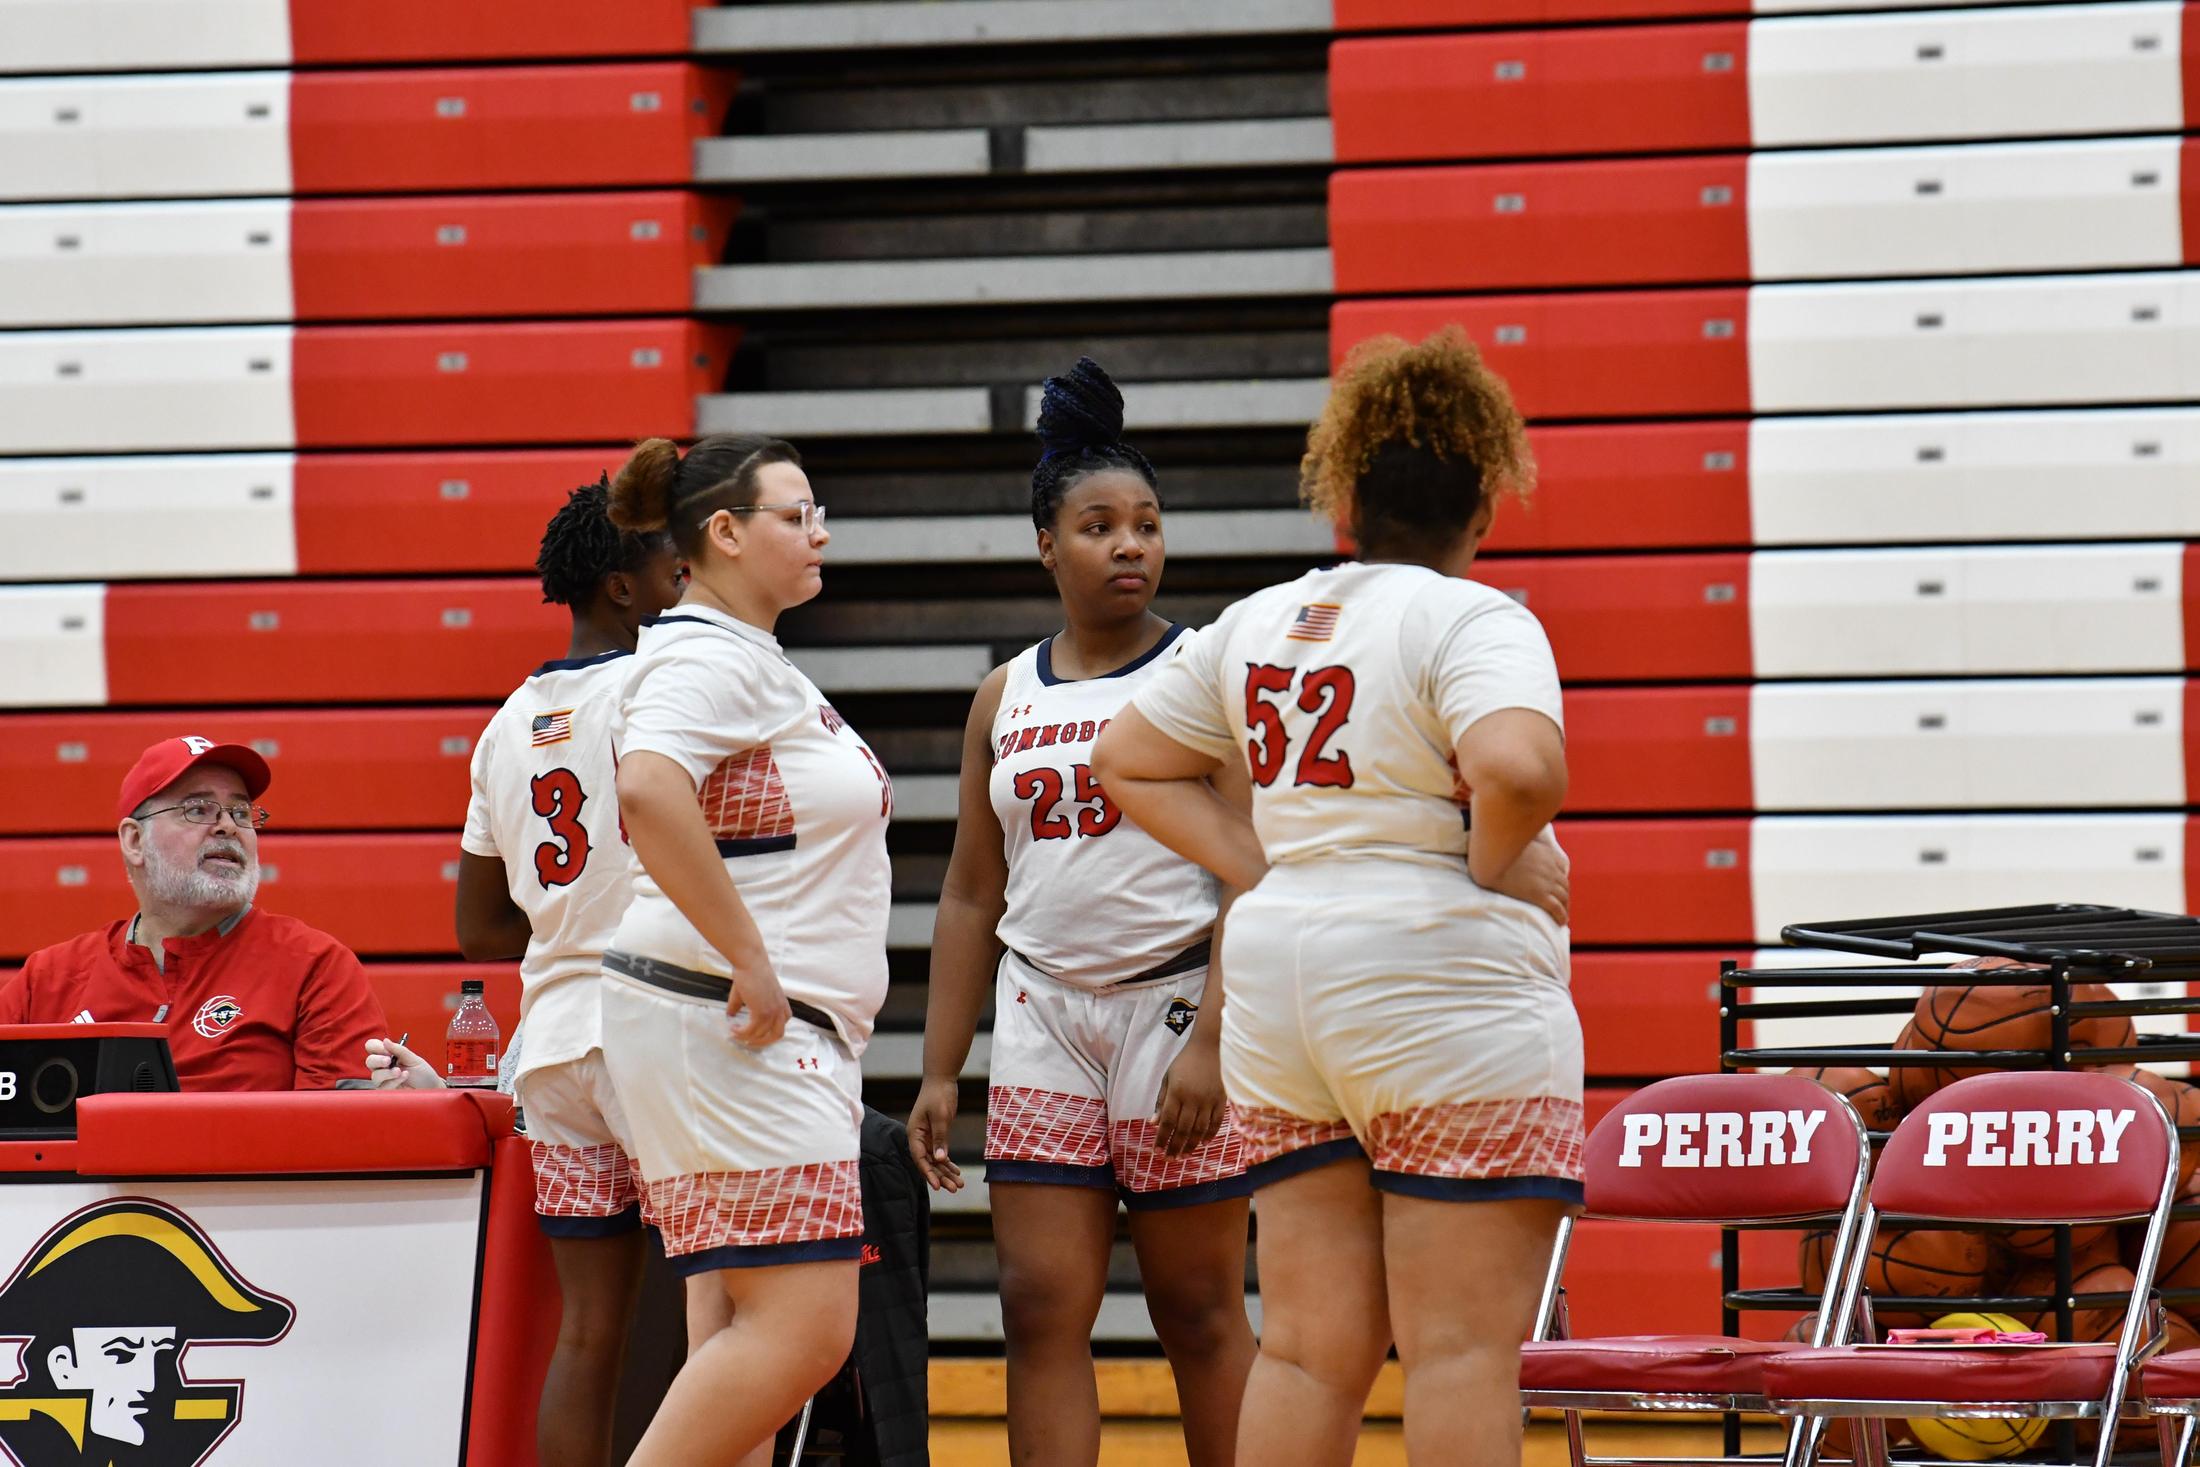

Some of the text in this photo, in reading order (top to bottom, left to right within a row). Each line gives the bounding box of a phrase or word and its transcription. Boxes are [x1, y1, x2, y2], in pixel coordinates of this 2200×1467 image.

[1245, 662, 1355, 789] 52
[530, 767, 593, 891] 3
[1013, 763, 1122, 841] 25
[1618, 1110, 1827, 1168] PERRY
[1923, 1109, 2137, 1167] PERRY
